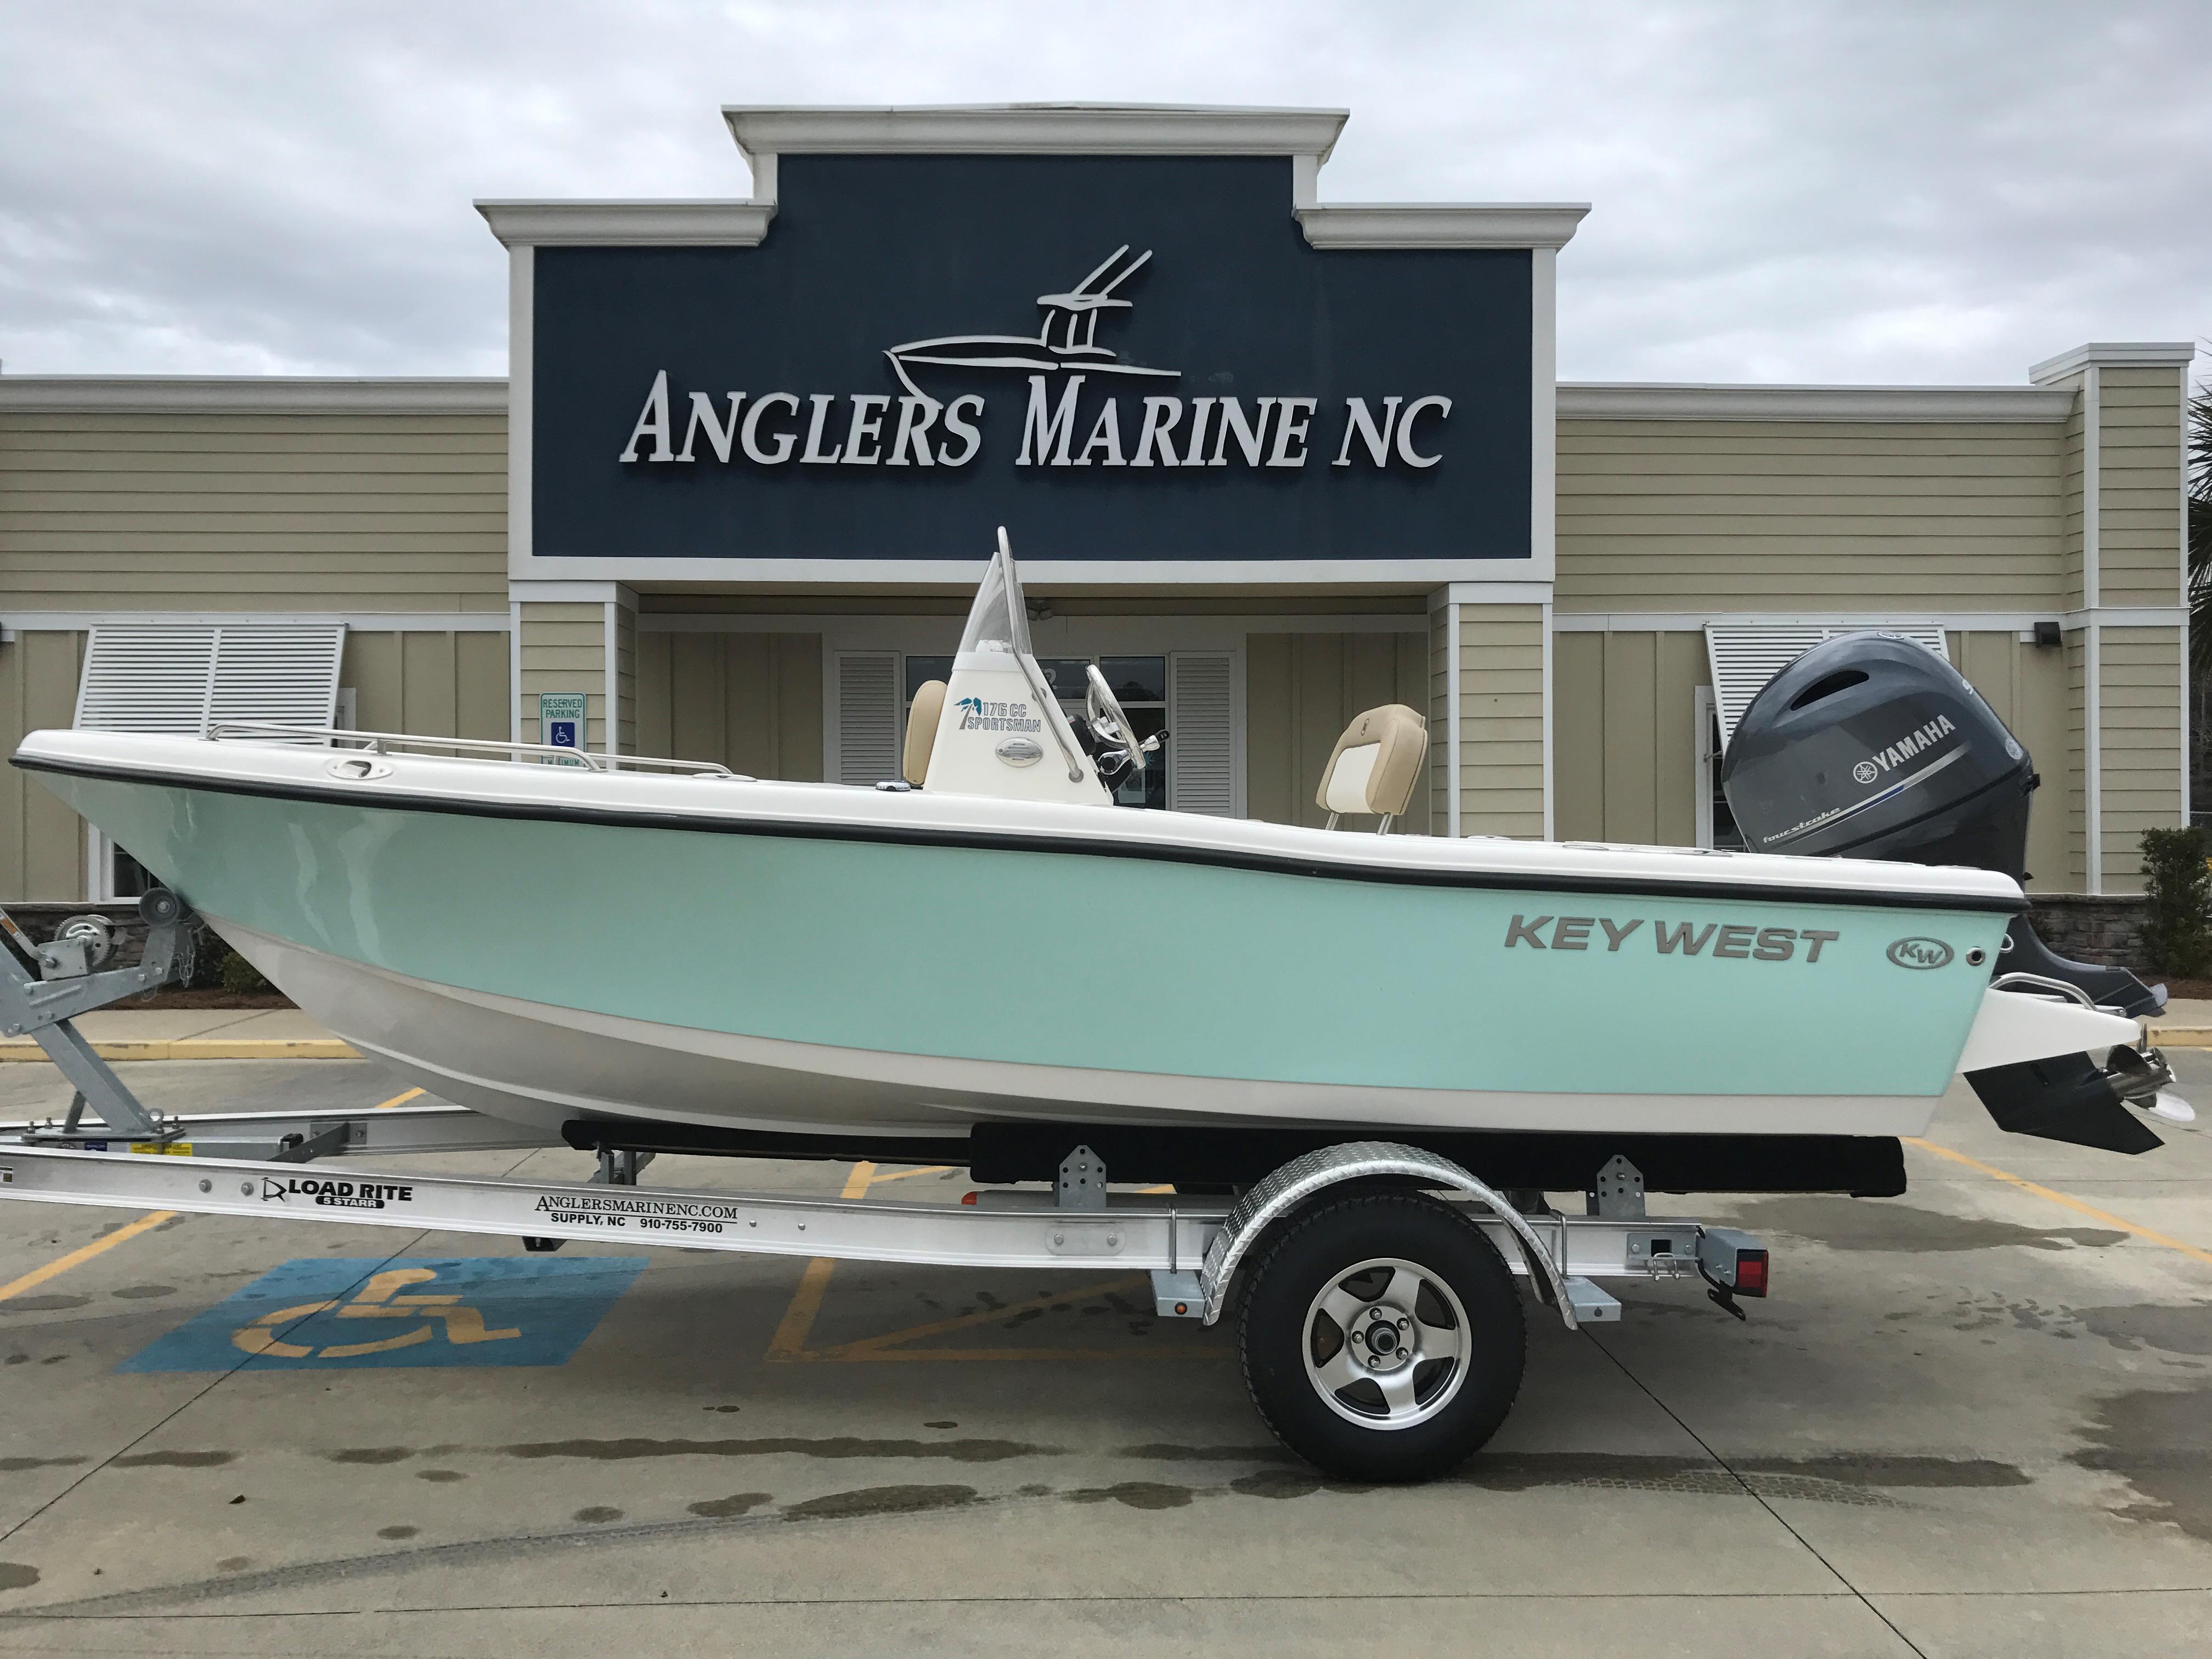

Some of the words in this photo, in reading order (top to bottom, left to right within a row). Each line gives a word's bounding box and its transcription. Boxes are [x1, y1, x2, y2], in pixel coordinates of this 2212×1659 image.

[619, 369, 985, 466] ANGLERS
[1015, 375, 1318, 467] MARINE
[1331, 395, 1453, 467] NC
[543, 699, 583, 708] RESERVED
[545, 709, 580, 718] PARKING
[983, 702, 1007, 716] 176
[1009, 703, 1026, 717] CC
[967, 716, 1041, 732] SPORTSMAN
[1872, 714, 1956, 772] YAMAHA
[1504, 915, 1645, 951] KEY
[1654, 920, 1839, 963] WEST
[1899, 942, 1943, 964] KW
[289, 1179, 354, 1197] LOAD
[359, 1183, 413, 1201] RITE
[333, 1198, 377, 1208] STARR
[534, 1195, 738, 1219] ANGLERSMARINENC.COM
[551, 1212, 603, 1226] SUPPLY,
[607, 1216, 626, 1227] NC
[640, 1218, 723, 1233] 910-755-7900
